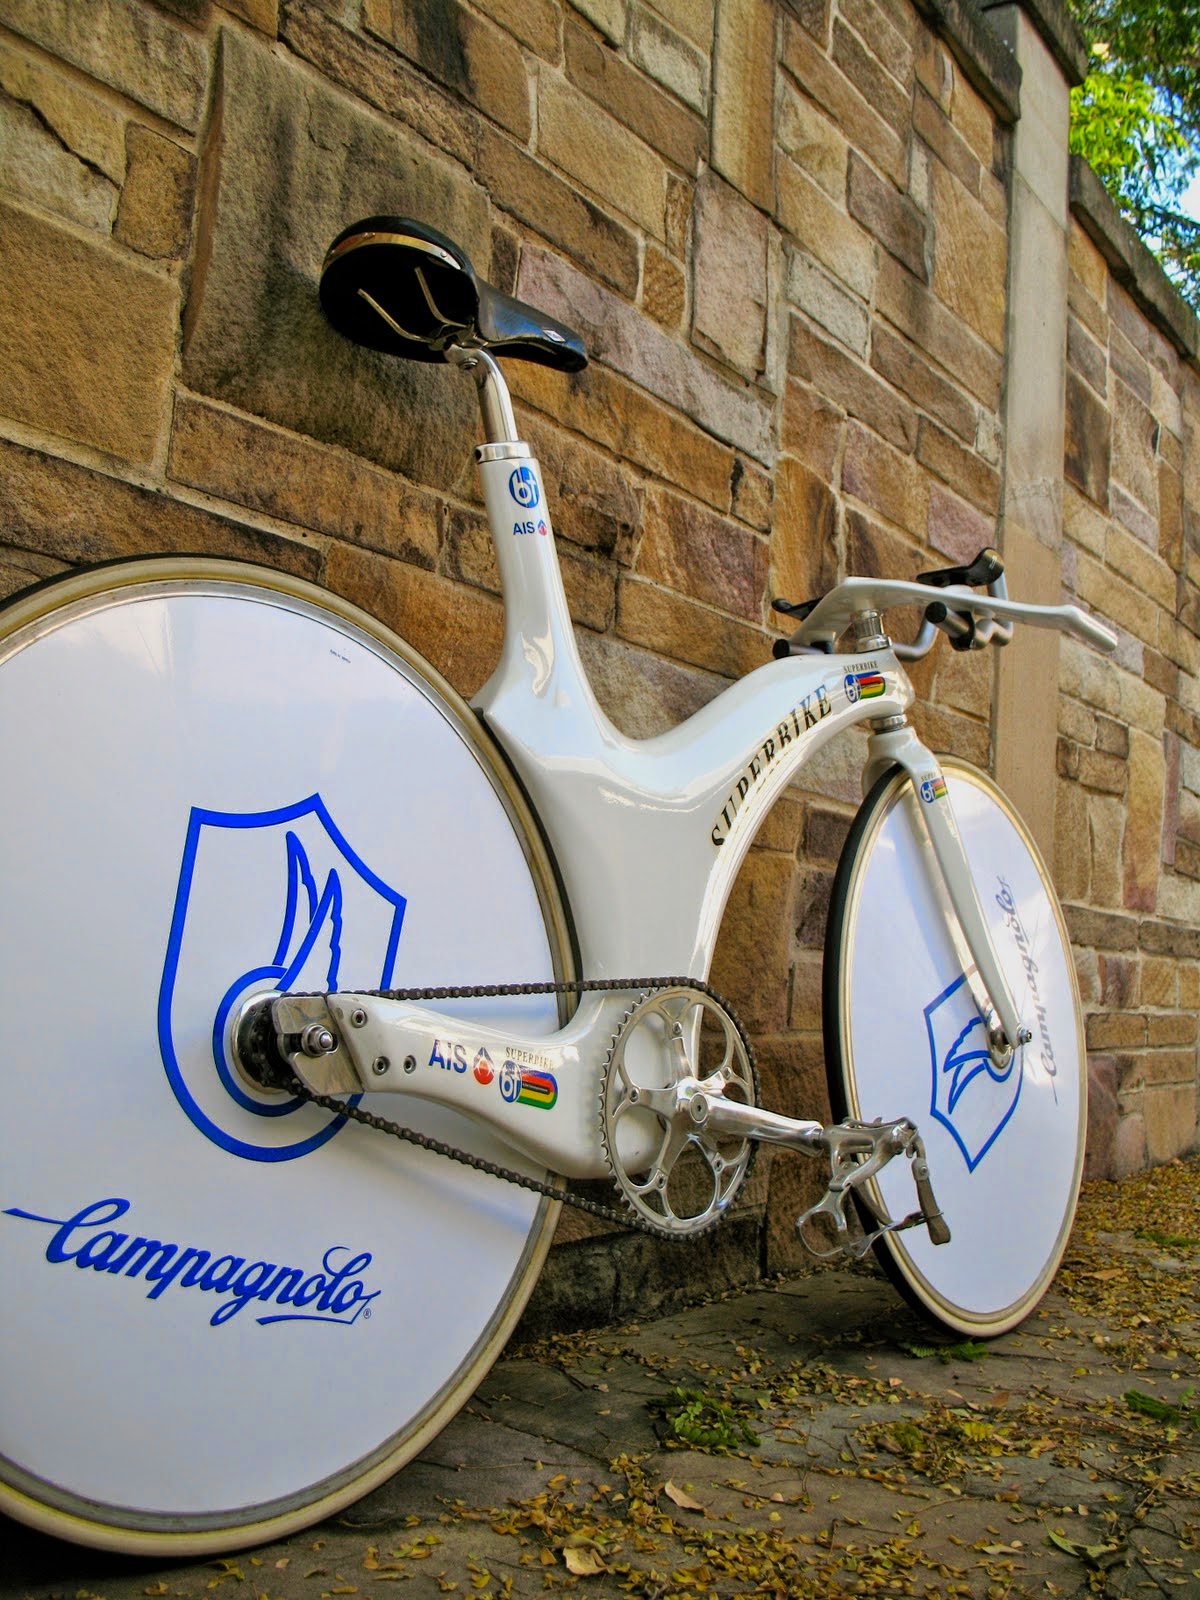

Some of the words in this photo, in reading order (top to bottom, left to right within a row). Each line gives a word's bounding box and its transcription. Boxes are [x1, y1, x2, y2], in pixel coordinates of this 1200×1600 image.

[513, 521, 536, 536] AIS
[843, 660, 879, 673] SUPERBIKE
[428, 1039, 468, 1074] AIS
[1, 1197, 382, 1327] Campagnolo
